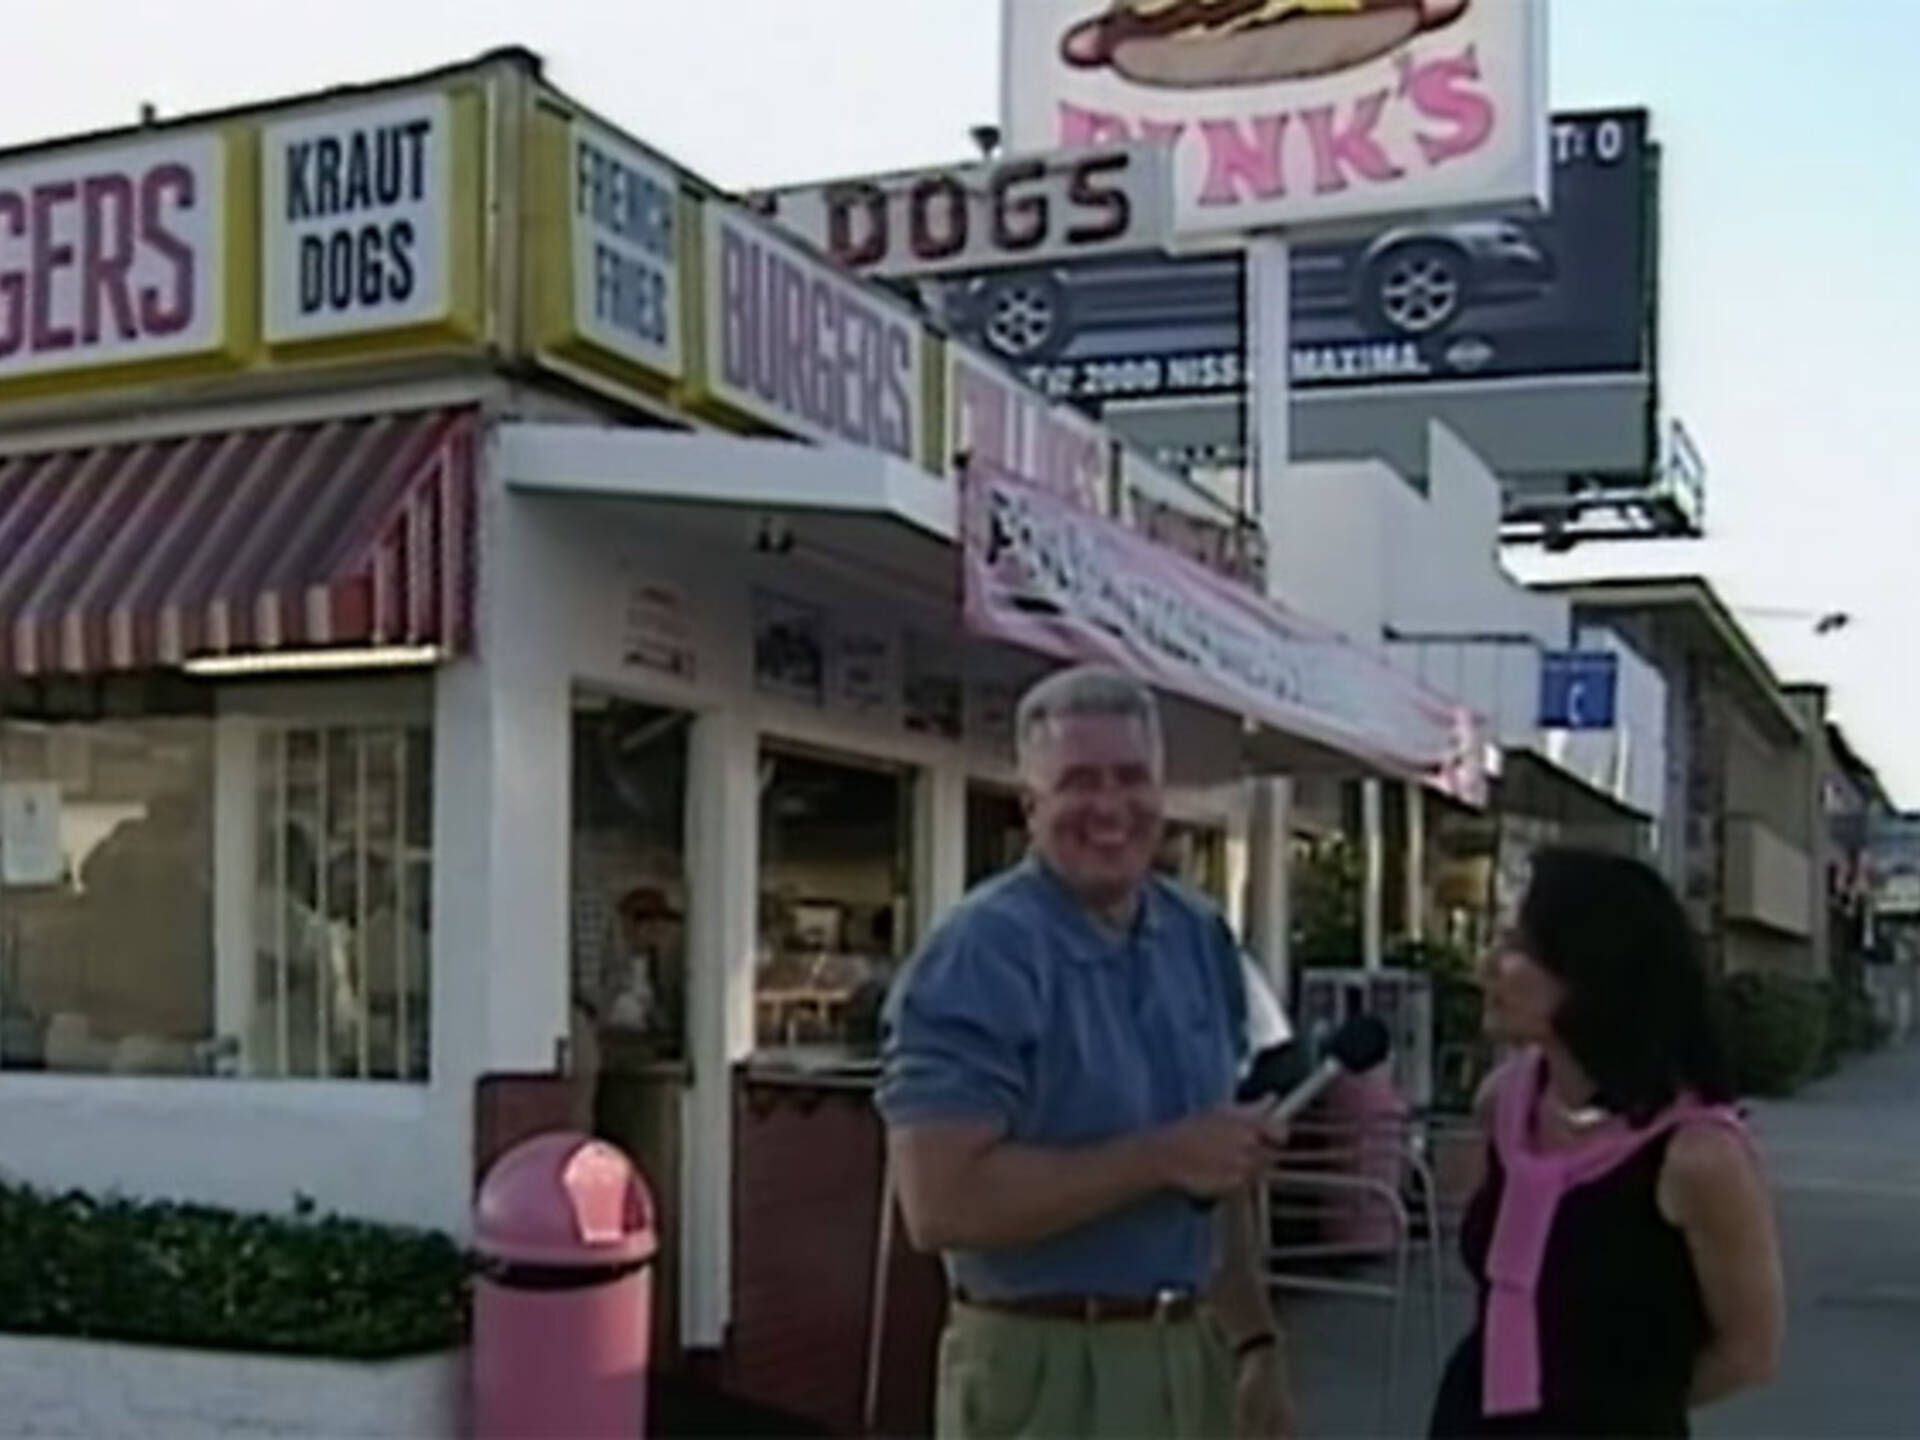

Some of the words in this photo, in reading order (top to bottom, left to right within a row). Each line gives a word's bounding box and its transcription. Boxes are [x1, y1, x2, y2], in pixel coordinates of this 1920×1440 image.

[286, 118, 431, 222] KRAUT
[1058, 43, 1496, 206] PNK'S
[825, 152, 1131, 267] DOGS
[299, 220, 415, 315] DOGS
[721, 222, 912, 460] BURGERS
[1082, 357, 1161, 394] 2000
[1166, 352, 1256, 388] NISS
